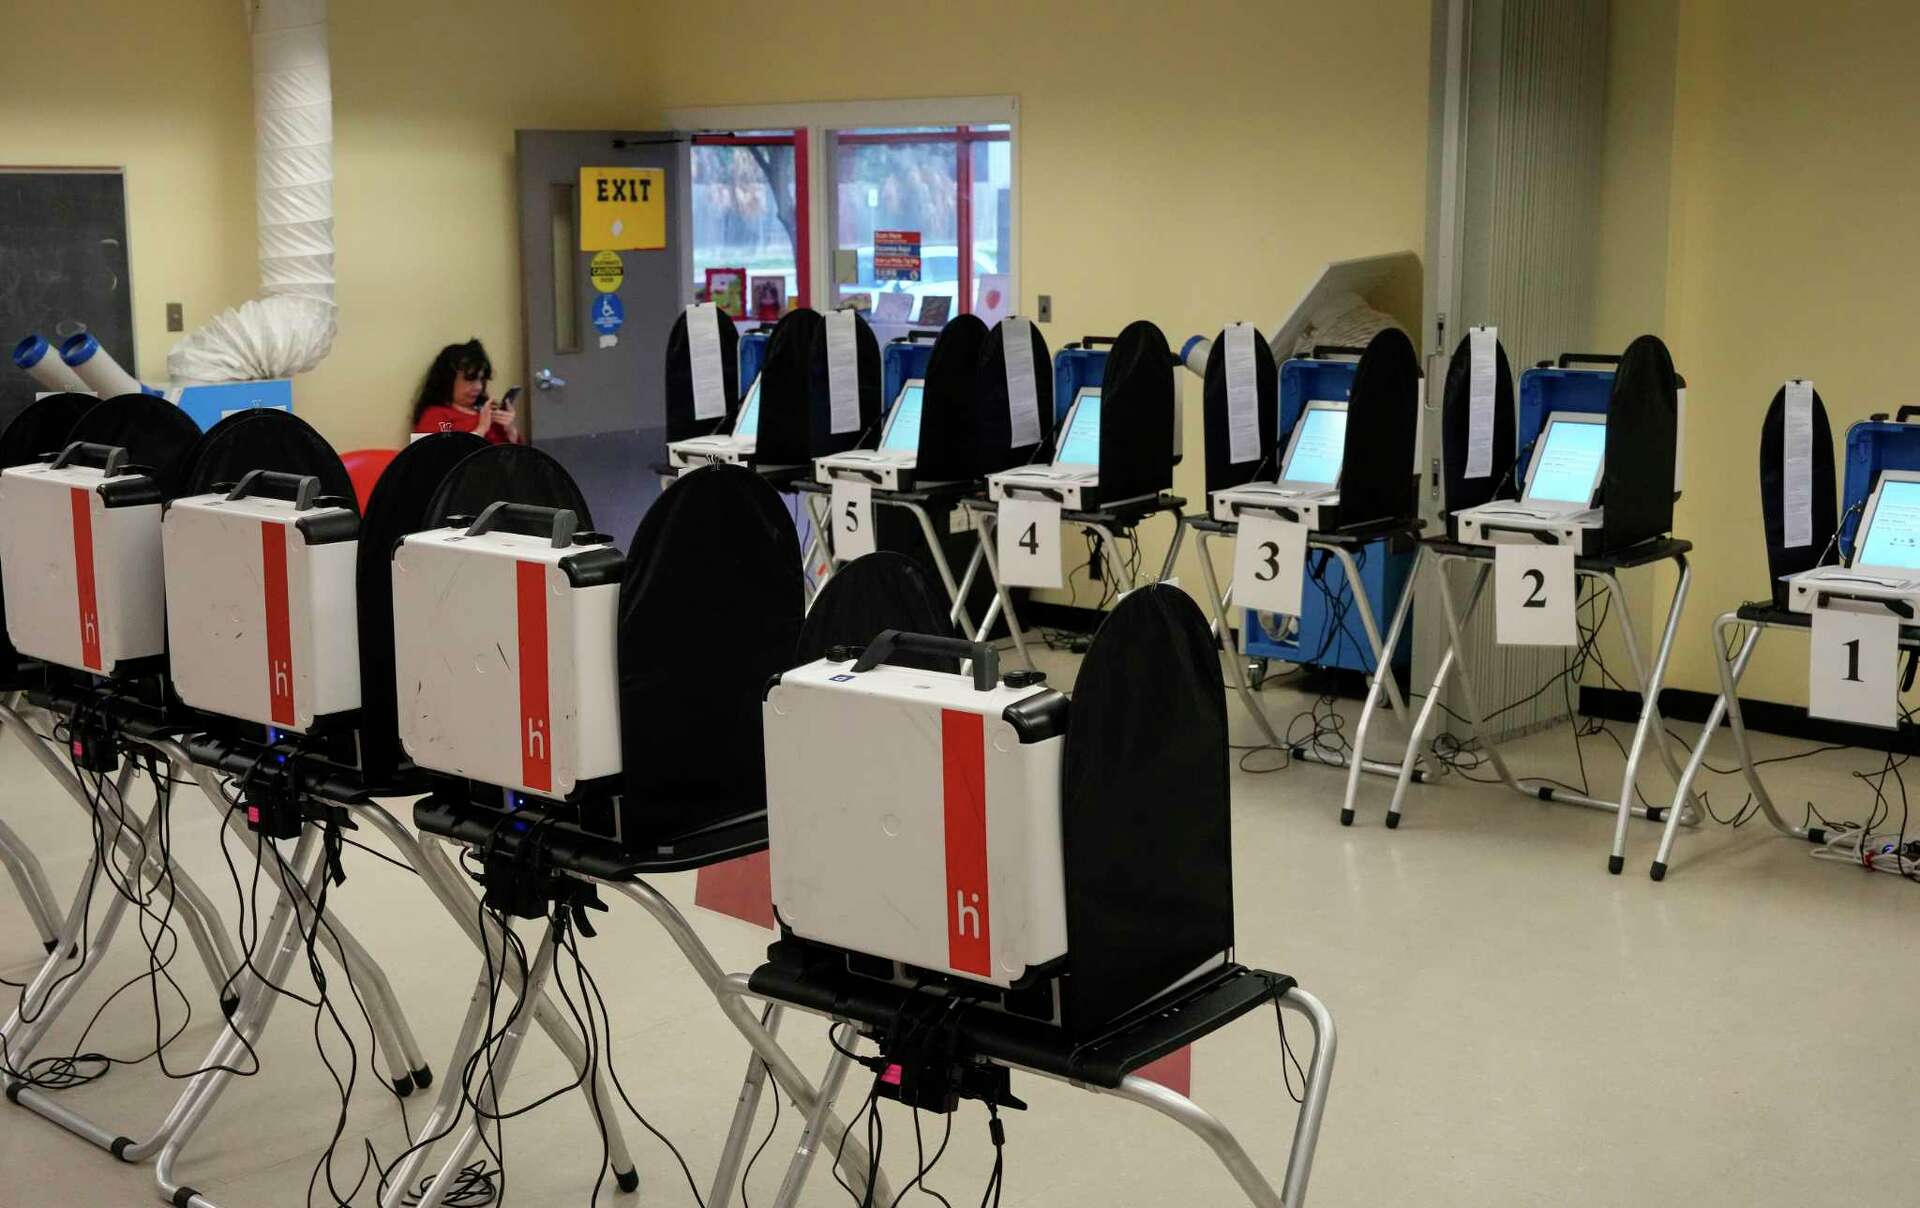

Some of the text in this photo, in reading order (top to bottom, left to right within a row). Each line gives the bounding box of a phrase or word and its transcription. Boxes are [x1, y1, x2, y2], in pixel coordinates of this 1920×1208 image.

[597, 178, 651, 202] EXIT
[845, 500, 858, 532] 5
[1018, 521, 1039, 555] 4
[1255, 541, 1280, 580] 3
[1522, 568, 1547, 607] 2
[1843, 639, 1864, 682] 1
